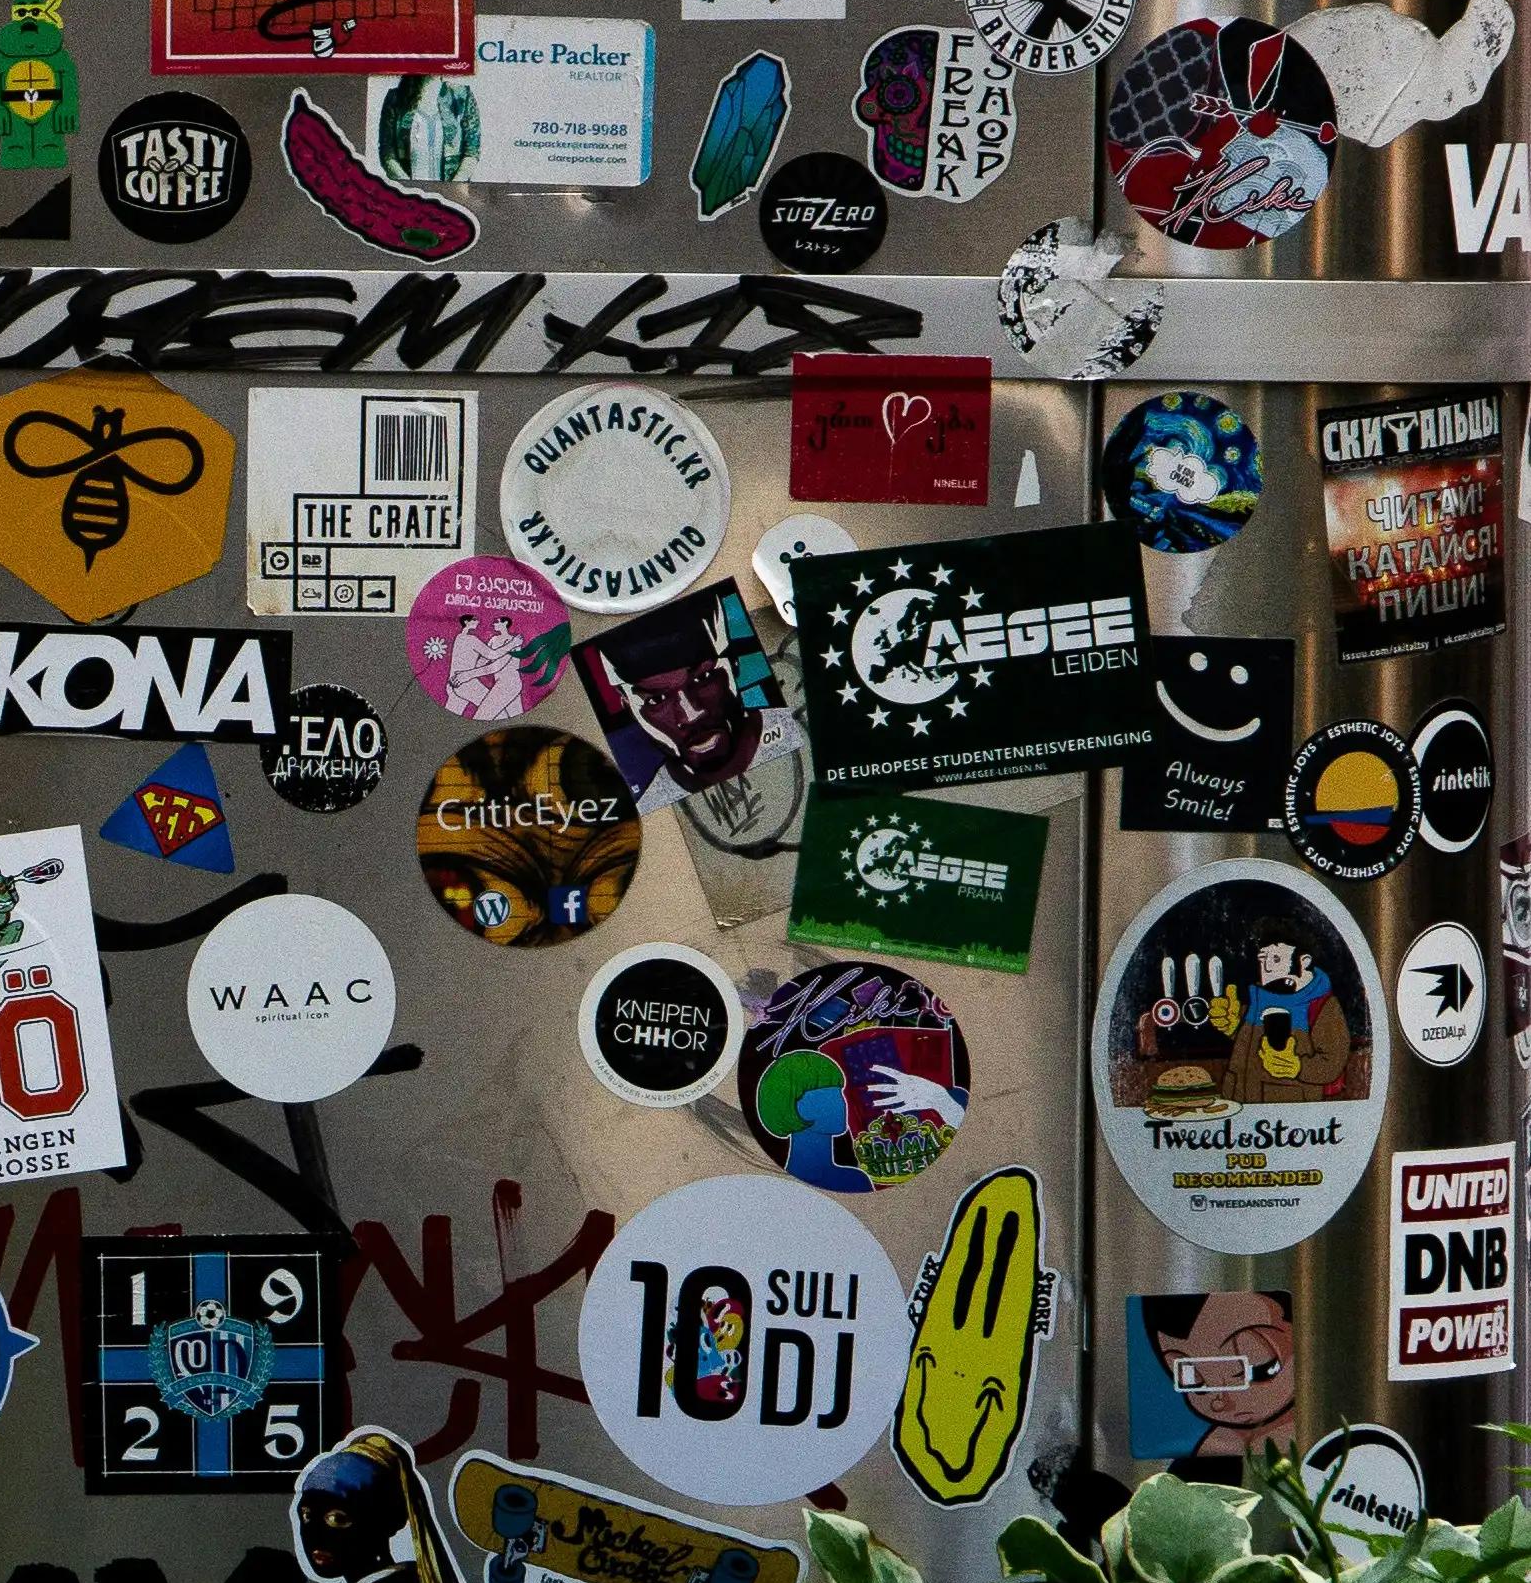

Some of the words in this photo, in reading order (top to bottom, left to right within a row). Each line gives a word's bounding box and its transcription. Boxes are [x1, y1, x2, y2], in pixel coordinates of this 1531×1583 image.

[478, 40, 544, 65] Clare
[550, 43, 631, 67] Packer
[980, 18, 1078, 71] BARBER
[532, 121, 628, 137] 780-718-9988
[932, 32, 977, 199] FREAK
[975, 51, 1014, 179] SHOP
[120, 127, 228, 167] TASTY
[547, 154, 627, 165] clarepacker.com
[124, 168, 224, 206] COFFEE
[794, 238, 841, 255] レストラン
[523, 401, 712, 491] QUANTASTIC.KR
[933, 478, 979, 490] NINELLIE
[1366, 474, 1484, 532] ЧИТАЙ!
[304, 503, 352, 538] THE
[368, 504, 453, 539] CRATE
[519, 509, 706, 599] QUANTASTIC.KR
[1347, 522, 1498, 582] КАТАЙСЯ!
[1377, 573, 1486, 624] ПИШИ!
[925, 596, 1137, 667] AEGEE
[1050, 648, 1140, 678] LEIDEN
[827, 767, 846, 781] DE
[851, 757, 929, 778] EUROPESE
[933, 729, 1153, 769] STUDENTENREISVERENIGING
[1327, 722, 1379, 739] ESTHETIC
[1379, 726, 1406, 753] JOYS
[934, 762, 1049, 784] WWW.AEGEE-LEIDEN.NL
[1168, 760, 1247, 795] Always
[1291, 742, 1318, 779] JOYS
[1432, 760, 1492, 792] sintetik
[1165, 789, 1234, 823] Smile!
[1285, 781, 1300, 833] ESTHETIC
[1408, 765, 1424, 817] ESTHETIC
[436, 792, 620, 834] CriticEyez
[1395, 817, 1419, 856] JOYS
[896, 851, 1009, 890] AEGEE
[1304, 847, 1333, 875] JOYS
[1334, 862, 1386, 879] ESTHETIC
[957, 885, 1005, 903] PRAHA
[255, 1011, 302, 1024] spiritual
[304, 1010, 330, 1021] icon
[615, 998, 711, 1027] KNEIPEN
[614, 1024, 708, 1052] CHHOR
[1173, 1169, 1324, 1189] RECOMMENDED
[1226, 1153, 1267, 1169] PUB
[1209, 1196, 1301, 1210] TWEEDANDSTOUT
[1407, 1169, 1507, 1211] UNITED
[1405, 1226, 1509, 1296] DNB
[766, 1268, 860, 1322] SULI
[629, 1260, 754, 1422] 10
[1407, 1308, 1506, 1355] POWER
[759, 1327, 856, 1431] DJ
